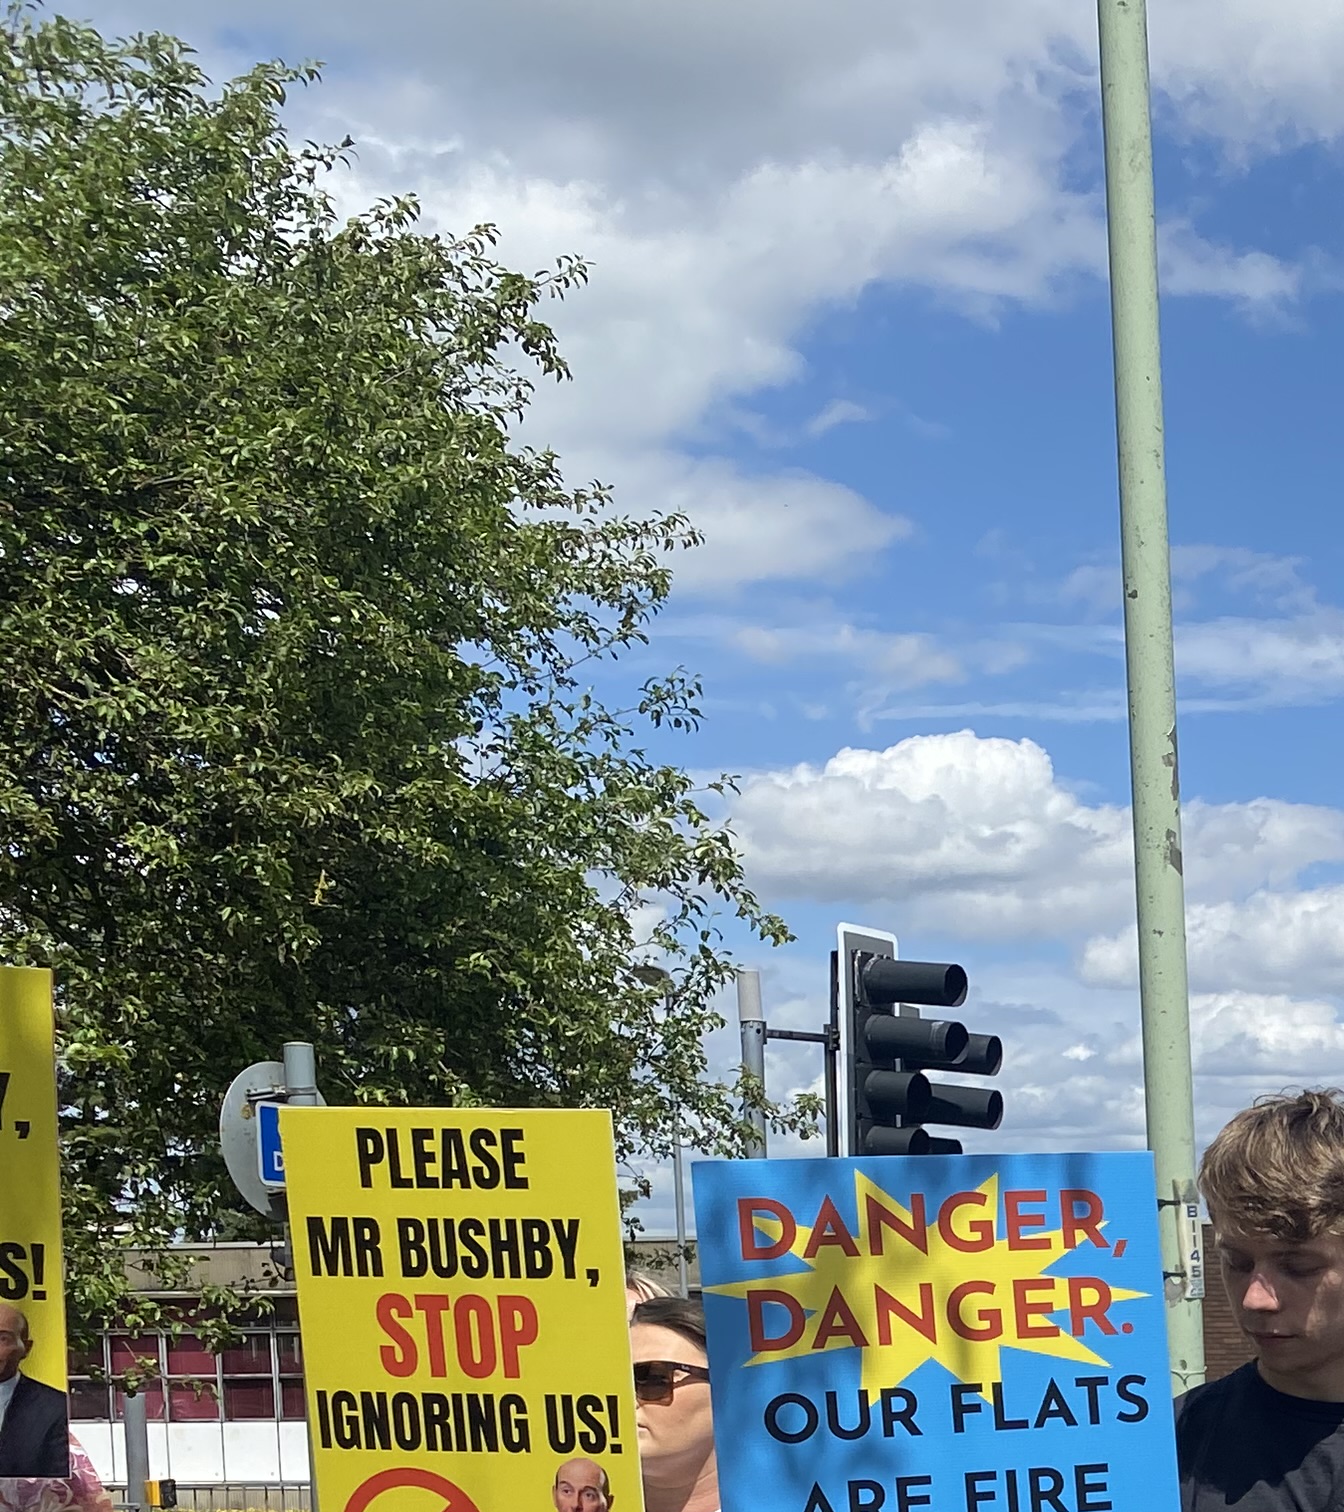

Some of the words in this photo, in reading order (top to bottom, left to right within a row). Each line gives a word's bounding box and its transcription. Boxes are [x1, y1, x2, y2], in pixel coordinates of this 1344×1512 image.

[355, 1127, 529, 1190] PLEASE
[306, 1216, 384, 1277] MR
[399, 1216, 600, 1288] BUSHBY,
[738, 1190, 1130, 1260] DANGER,
[375, 1291, 540, 1381] STOP
[749, 1277, 1133, 1352] DANGER.
[316, 1390, 531, 1453] IGNORING
[544, 1394, 623, 1454] US!
[764, 1387, 921, 1444] OUR
[951, 1375, 1148, 1433] FLATS
